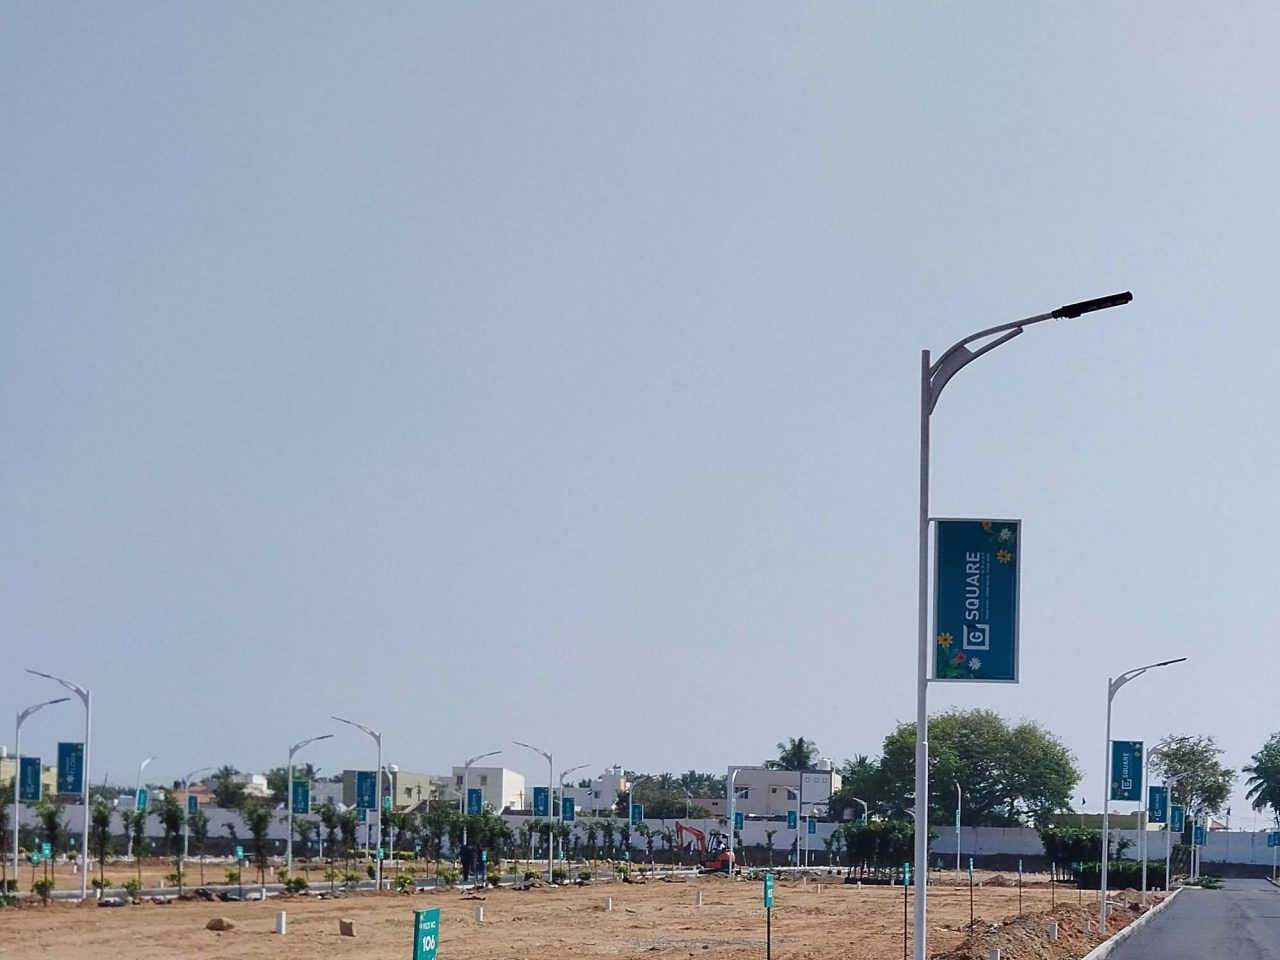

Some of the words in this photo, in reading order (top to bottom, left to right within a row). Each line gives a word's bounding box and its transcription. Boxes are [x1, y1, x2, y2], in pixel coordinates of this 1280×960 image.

[965, 552, 980, 620] SQUARE
[969, 631, 983, 642] G
[423, 935, 435, 951] 106
